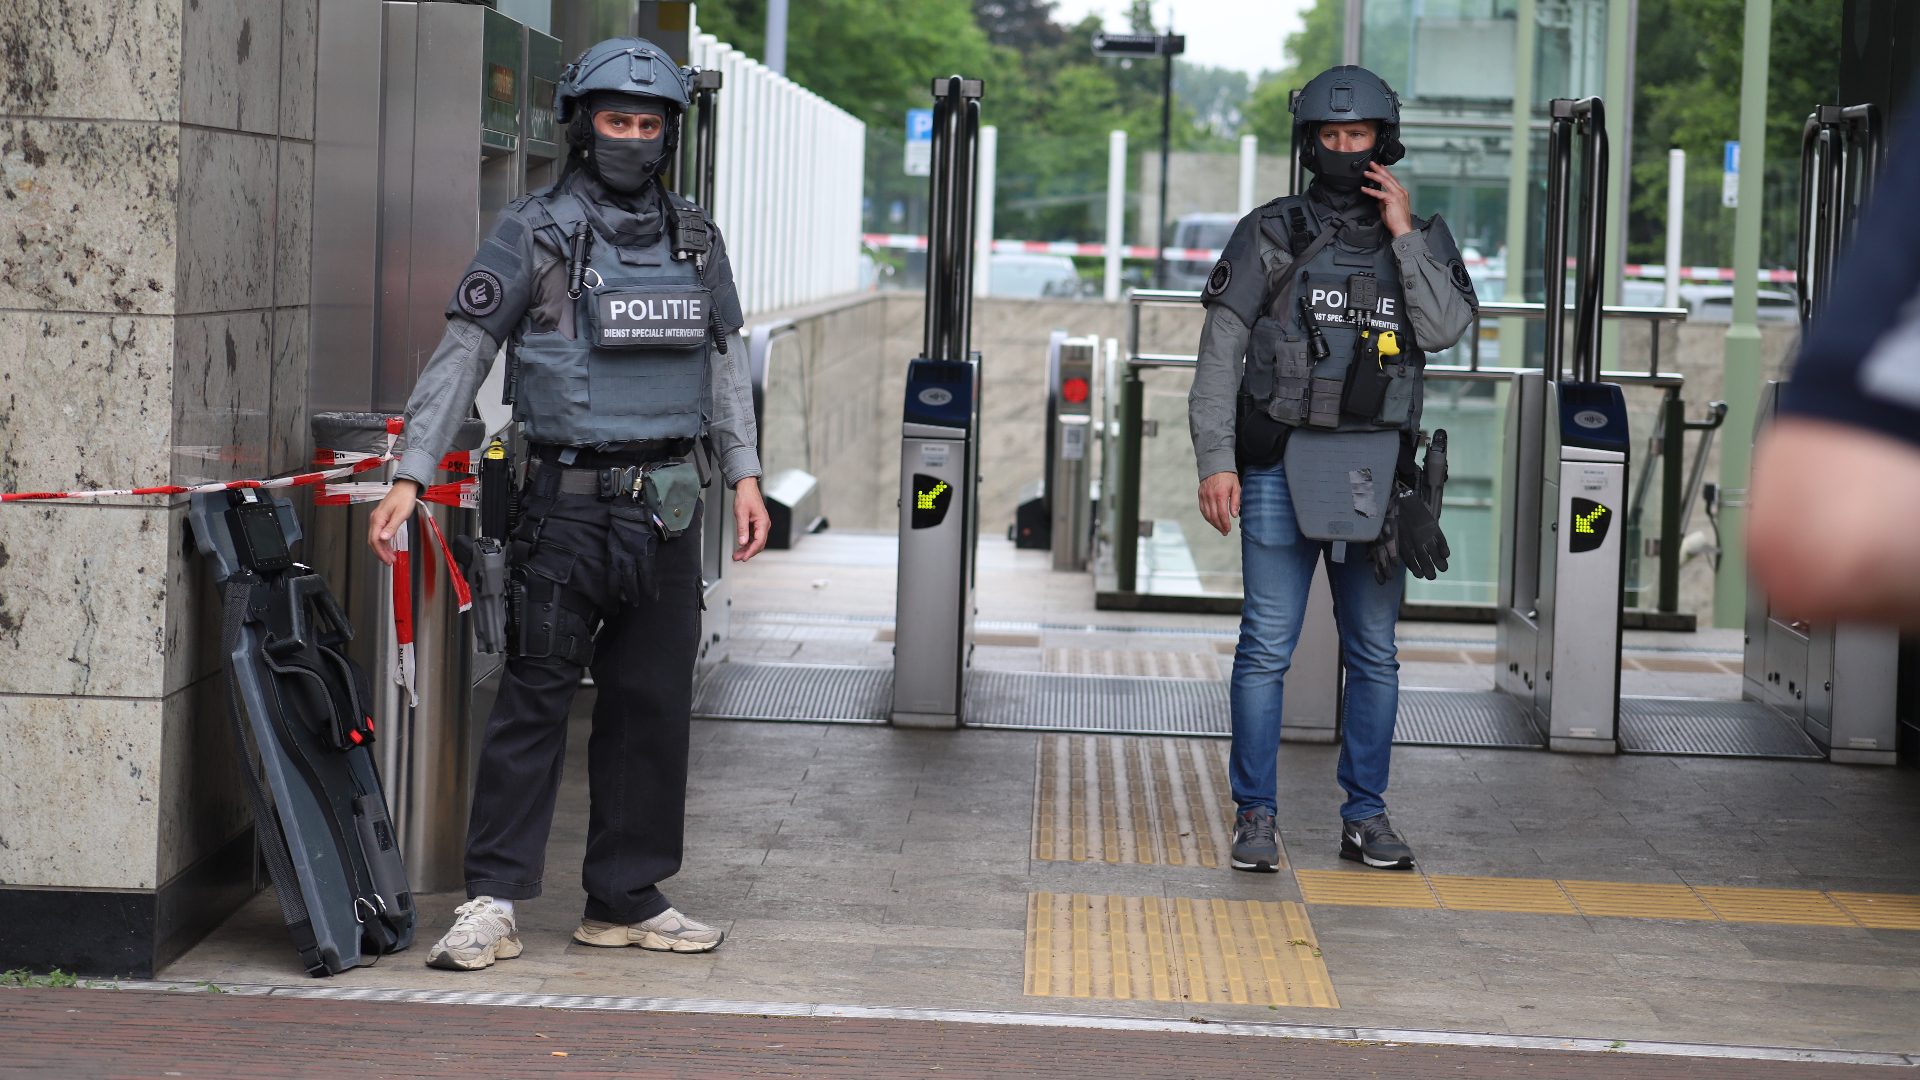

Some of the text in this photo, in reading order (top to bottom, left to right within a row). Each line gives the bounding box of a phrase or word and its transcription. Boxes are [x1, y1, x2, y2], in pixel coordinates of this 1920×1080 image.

[914, 113, 933, 139] P
[610, 300, 701, 320] POLITIE
[1312, 289, 1395, 316] POIE
[604, 329, 705, 337] DIENST SPECIALE INTERVENTIES
